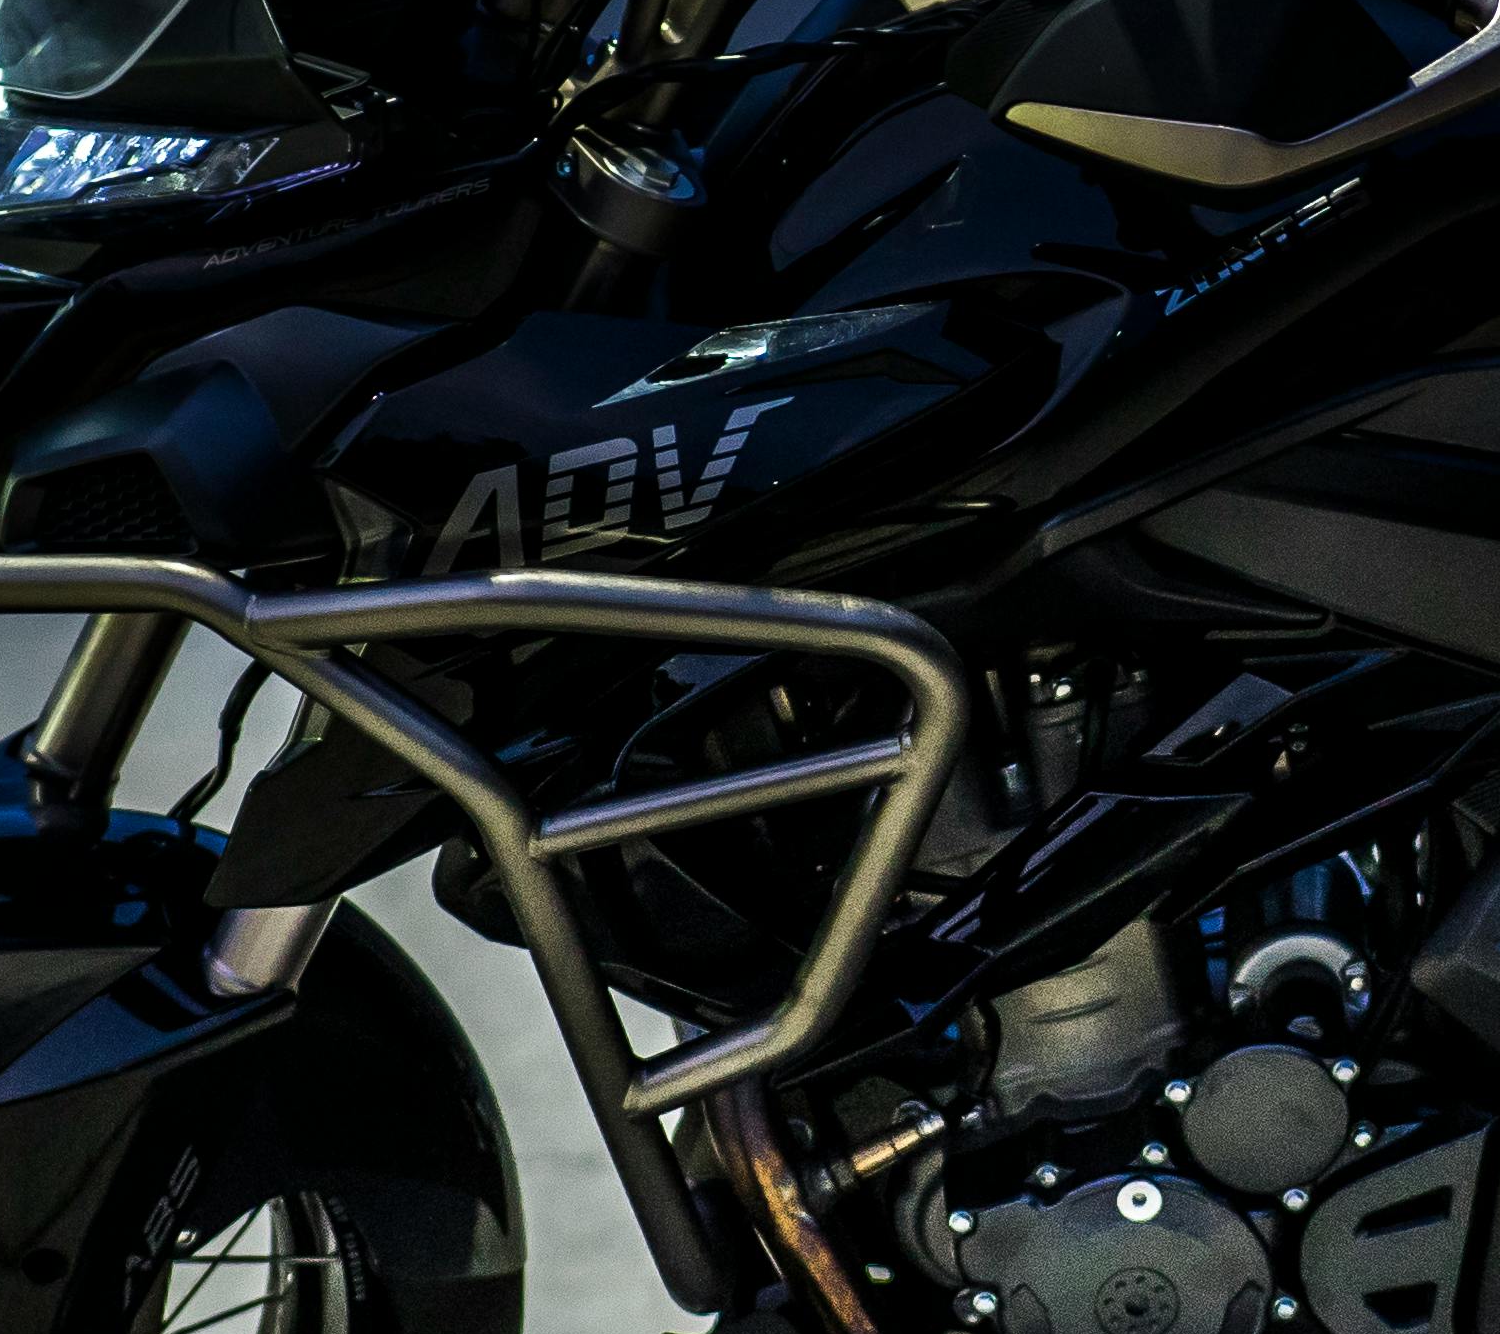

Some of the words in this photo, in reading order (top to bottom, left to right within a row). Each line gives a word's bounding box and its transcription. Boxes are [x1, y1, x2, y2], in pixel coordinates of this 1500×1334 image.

[202, 211, 361, 269] ADVENTURE
[371, 177, 491, 220] TOURERS
[421, 395, 795, 572] ADV
[122, 1144, 202, 1309] ABS
